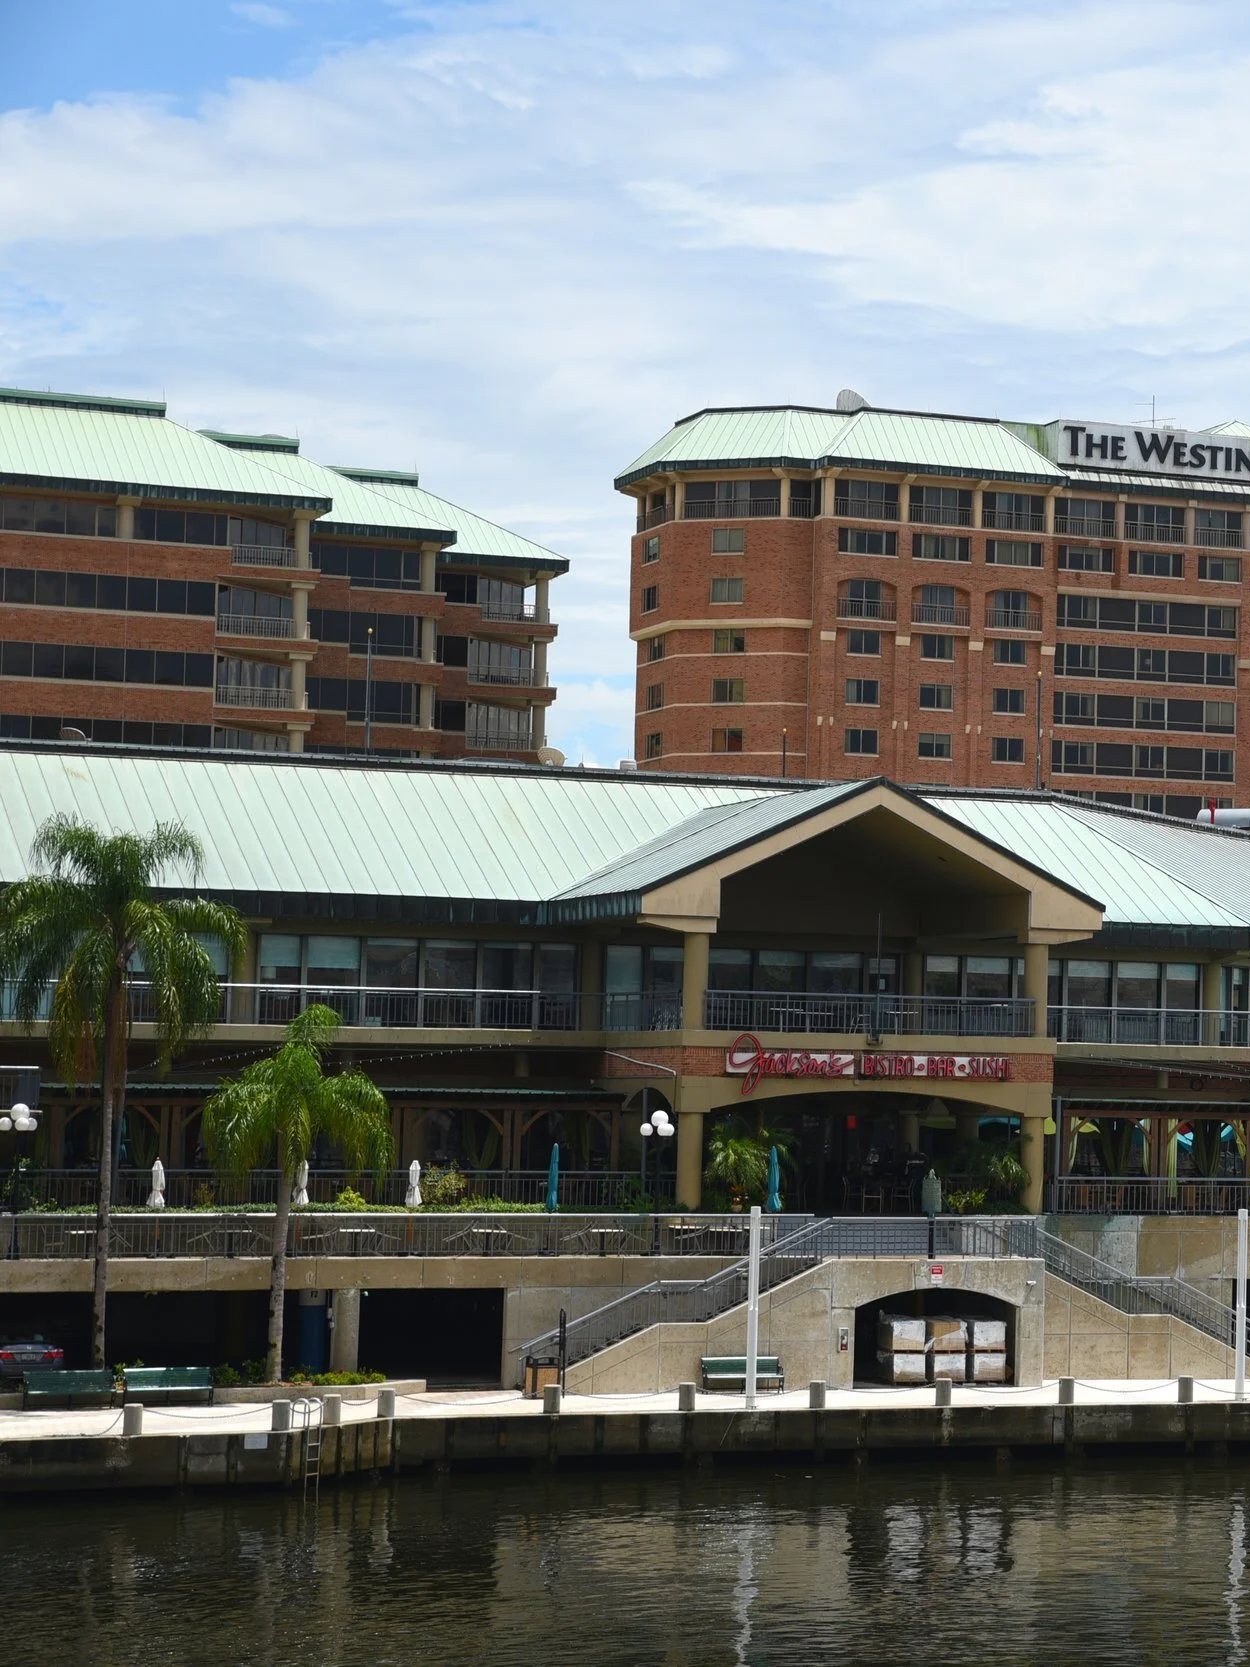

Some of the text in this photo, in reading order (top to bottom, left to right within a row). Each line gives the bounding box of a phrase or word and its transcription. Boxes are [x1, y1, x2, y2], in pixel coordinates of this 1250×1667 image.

[1064, 426, 1127, 460] THE
[730, 1033, 854, 1096] Jackson's
[864, 1056, 1012, 1079] BISTRO BAR SUSHI
